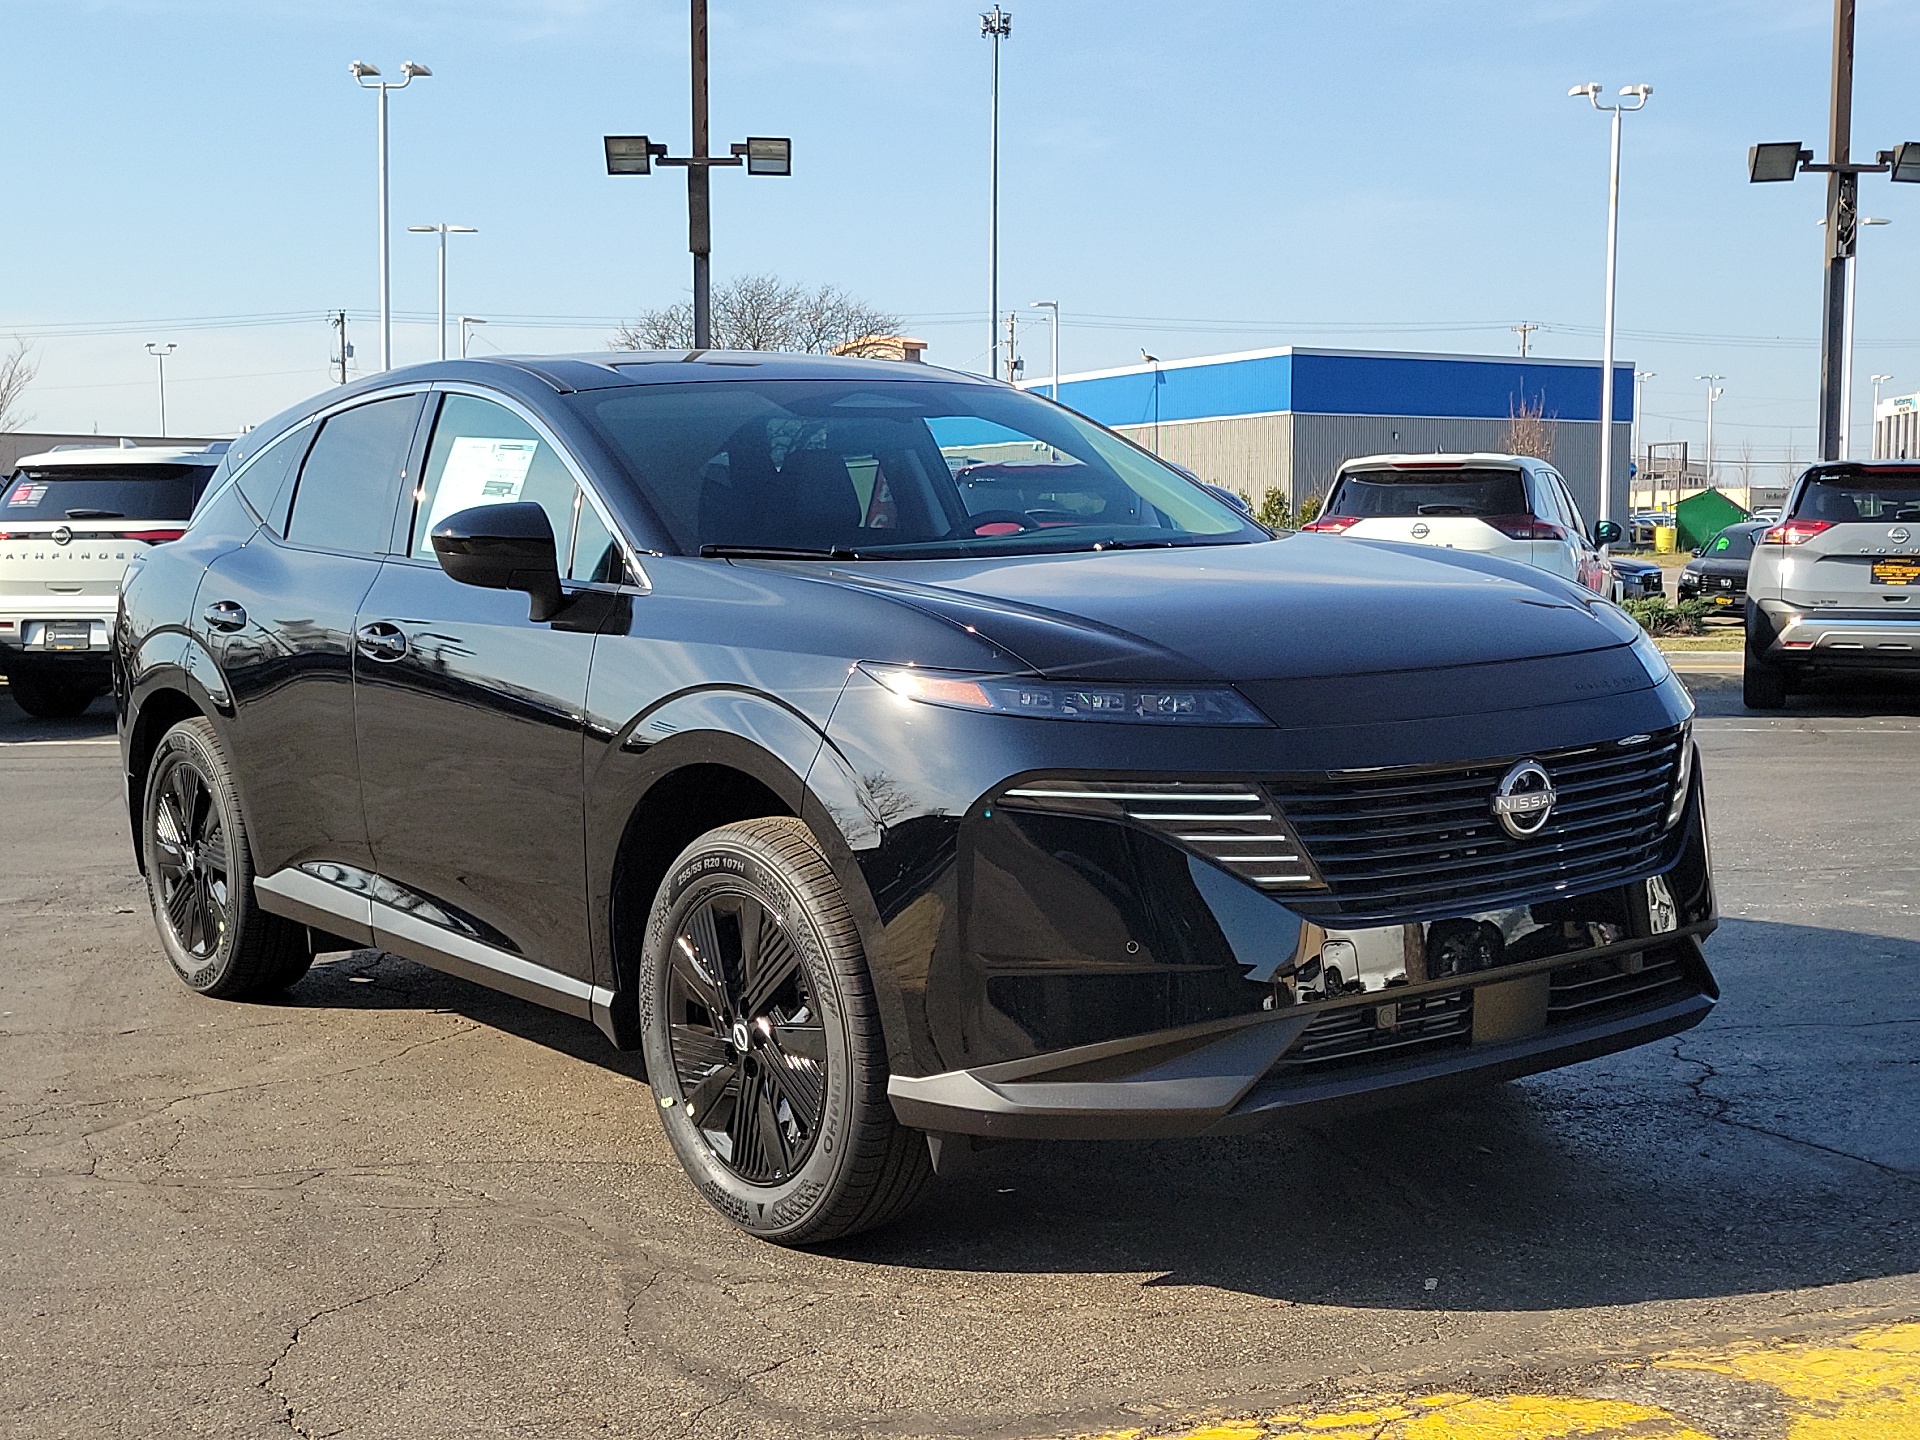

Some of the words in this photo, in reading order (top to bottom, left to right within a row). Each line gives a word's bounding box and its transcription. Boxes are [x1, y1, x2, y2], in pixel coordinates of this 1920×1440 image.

[0, 552, 142, 560] ATHFINDER
[1498, 792, 1557, 810] NISSAN
[677, 861, 703, 886] 255/55
[703, 857, 720, 869] R20
[722, 858, 745, 873] 107H
[823, 1050, 842, 1155] KUMHO
